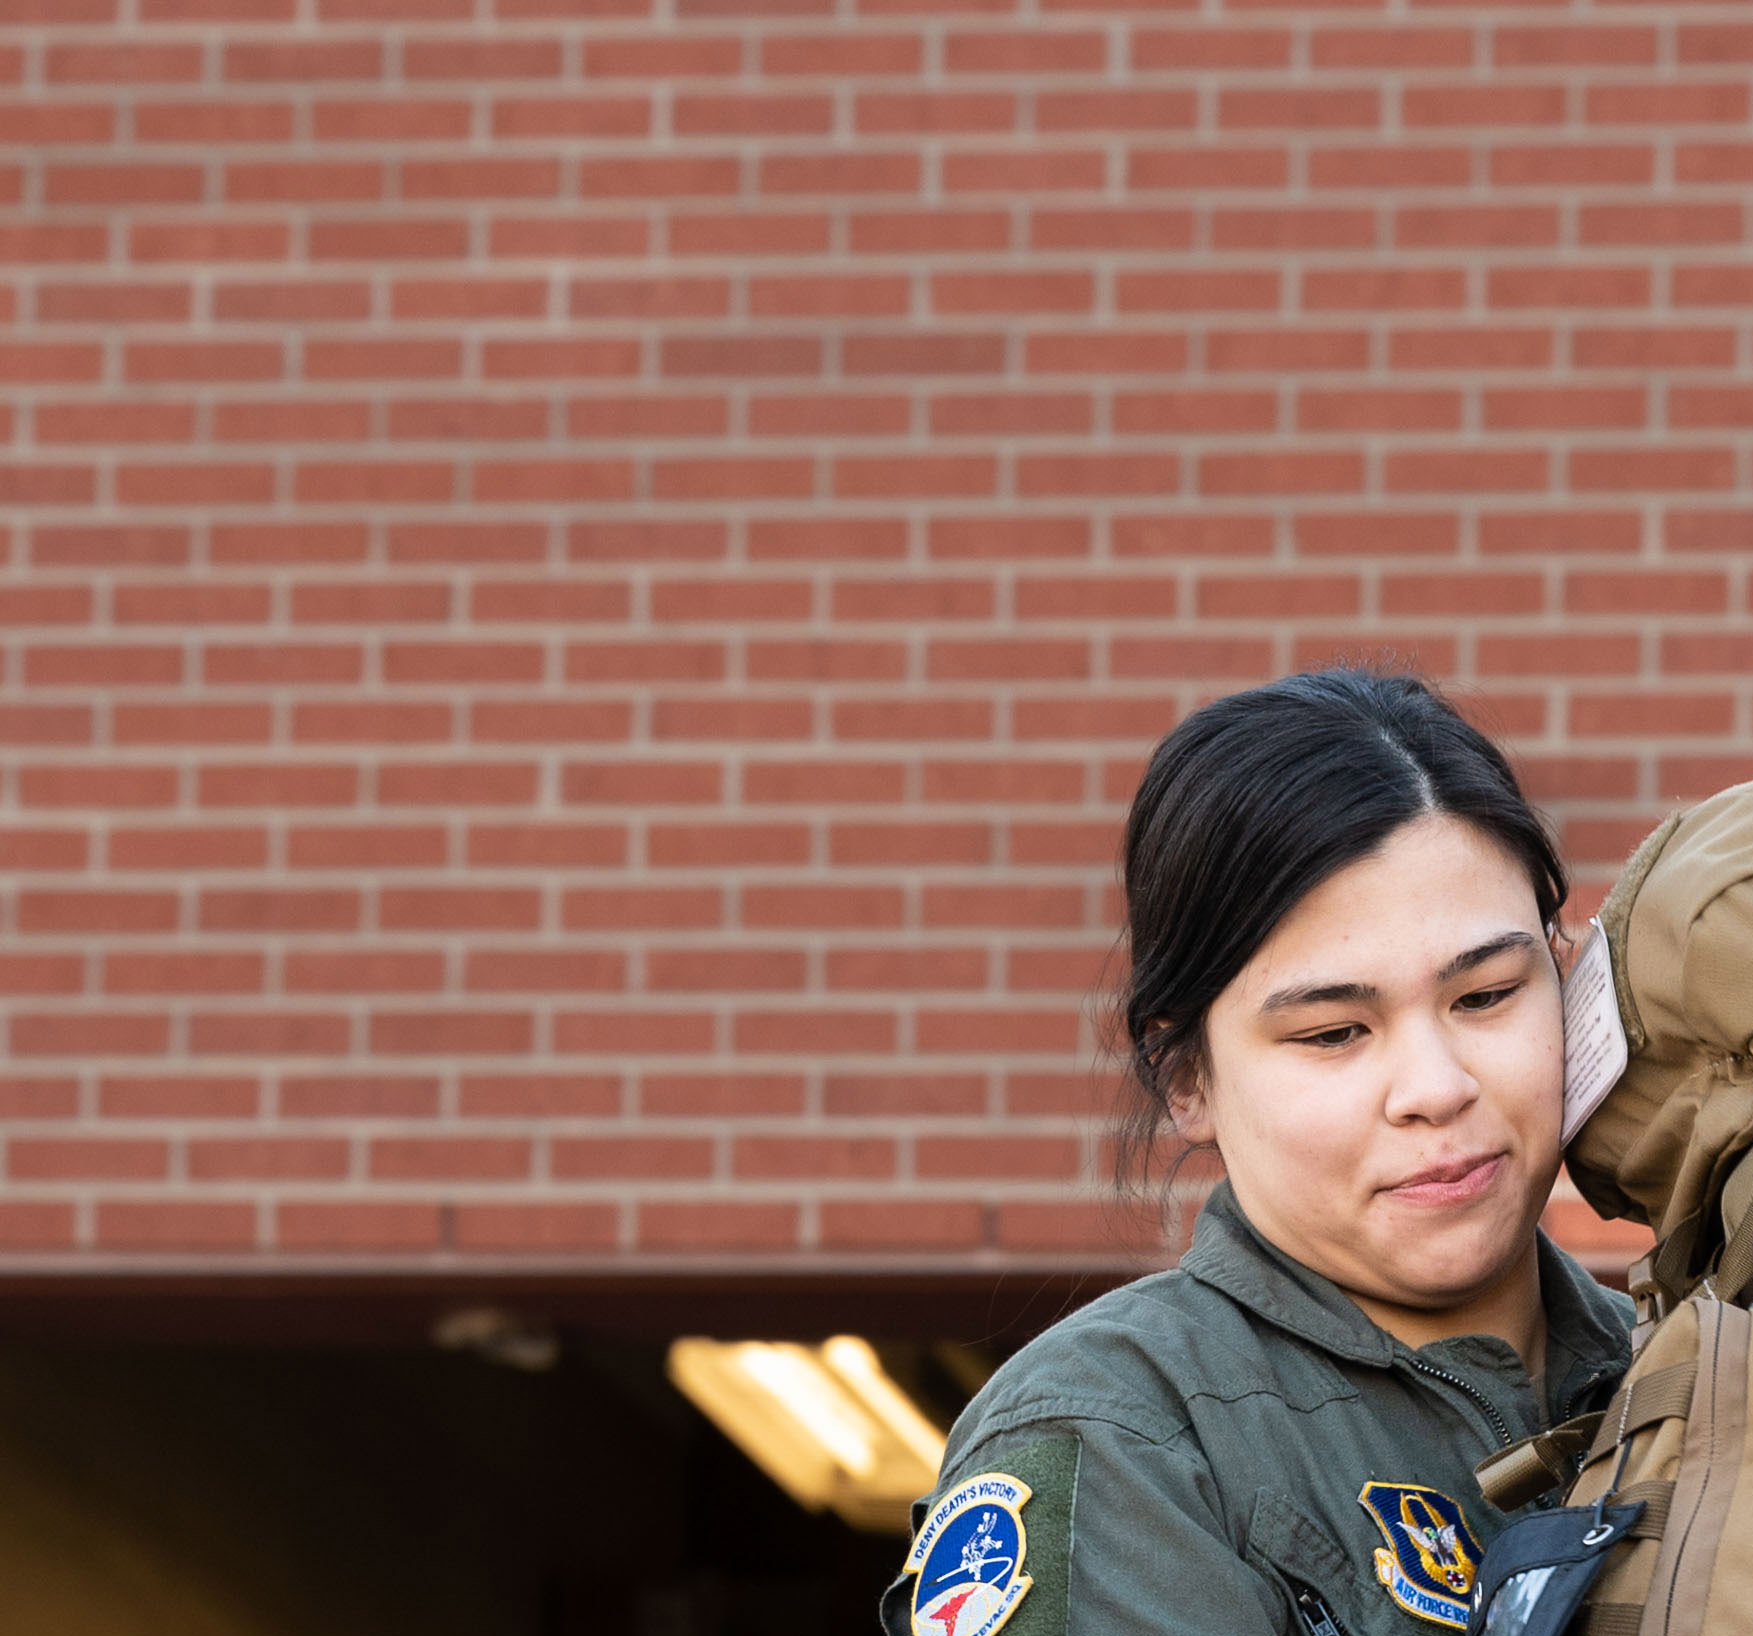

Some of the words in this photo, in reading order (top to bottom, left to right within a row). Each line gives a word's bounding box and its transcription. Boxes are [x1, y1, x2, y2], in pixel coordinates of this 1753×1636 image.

[915, 1523, 936, 1559] DENY
[935, 1485, 977, 1524] DEATH'S
[979, 1482, 1016, 1501] VICTORY
[1395, 1577, 1417, 1604] AIR
[1417, 1593, 1452, 1618] FORCE
[979, 1605, 1006, 1636] EVAC
